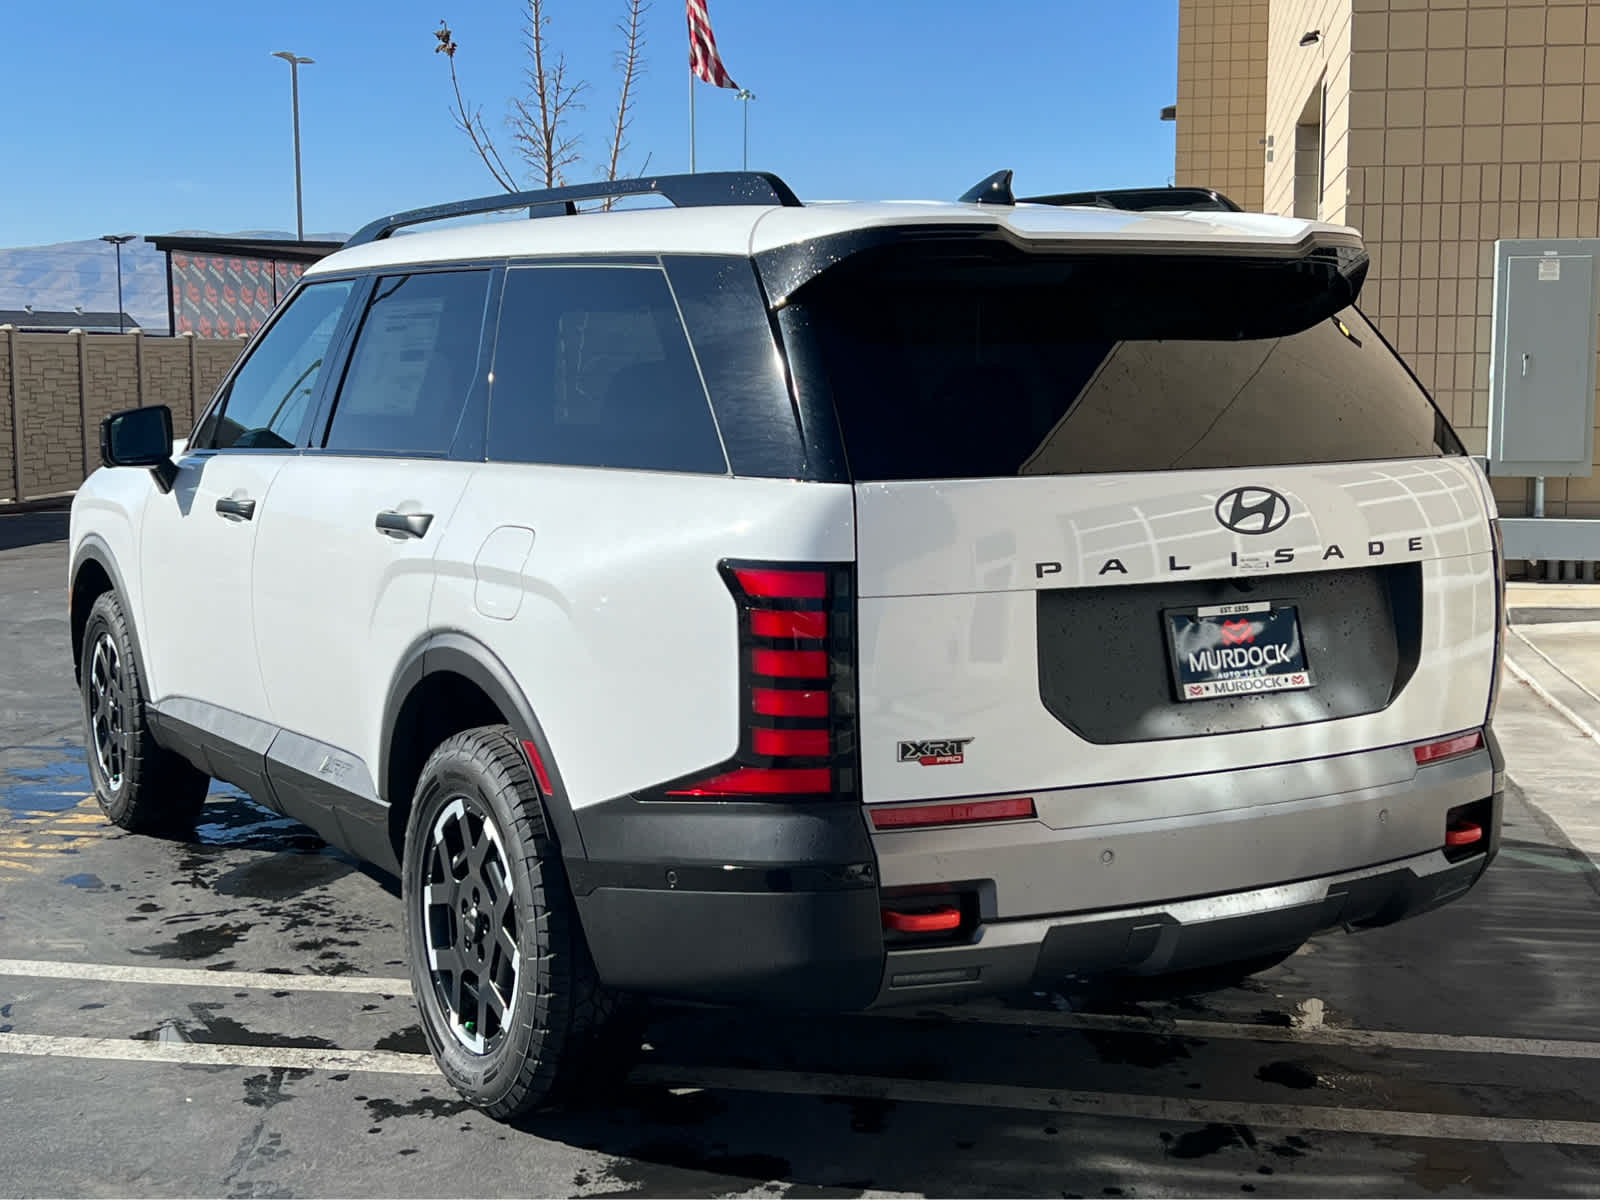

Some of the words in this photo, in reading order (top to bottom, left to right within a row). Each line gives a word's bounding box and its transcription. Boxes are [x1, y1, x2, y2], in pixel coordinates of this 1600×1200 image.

[1036, 536, 1423, 579] PALISADE
[1189, 643, 1291, 672] MURDOCK
[1214, 676, 1282, 693] MURDOCK
[1217, 671, 1240, 680] AUTO
[898, 737, 974, 761] XRT
[936, 755, 962, 764] PRO
